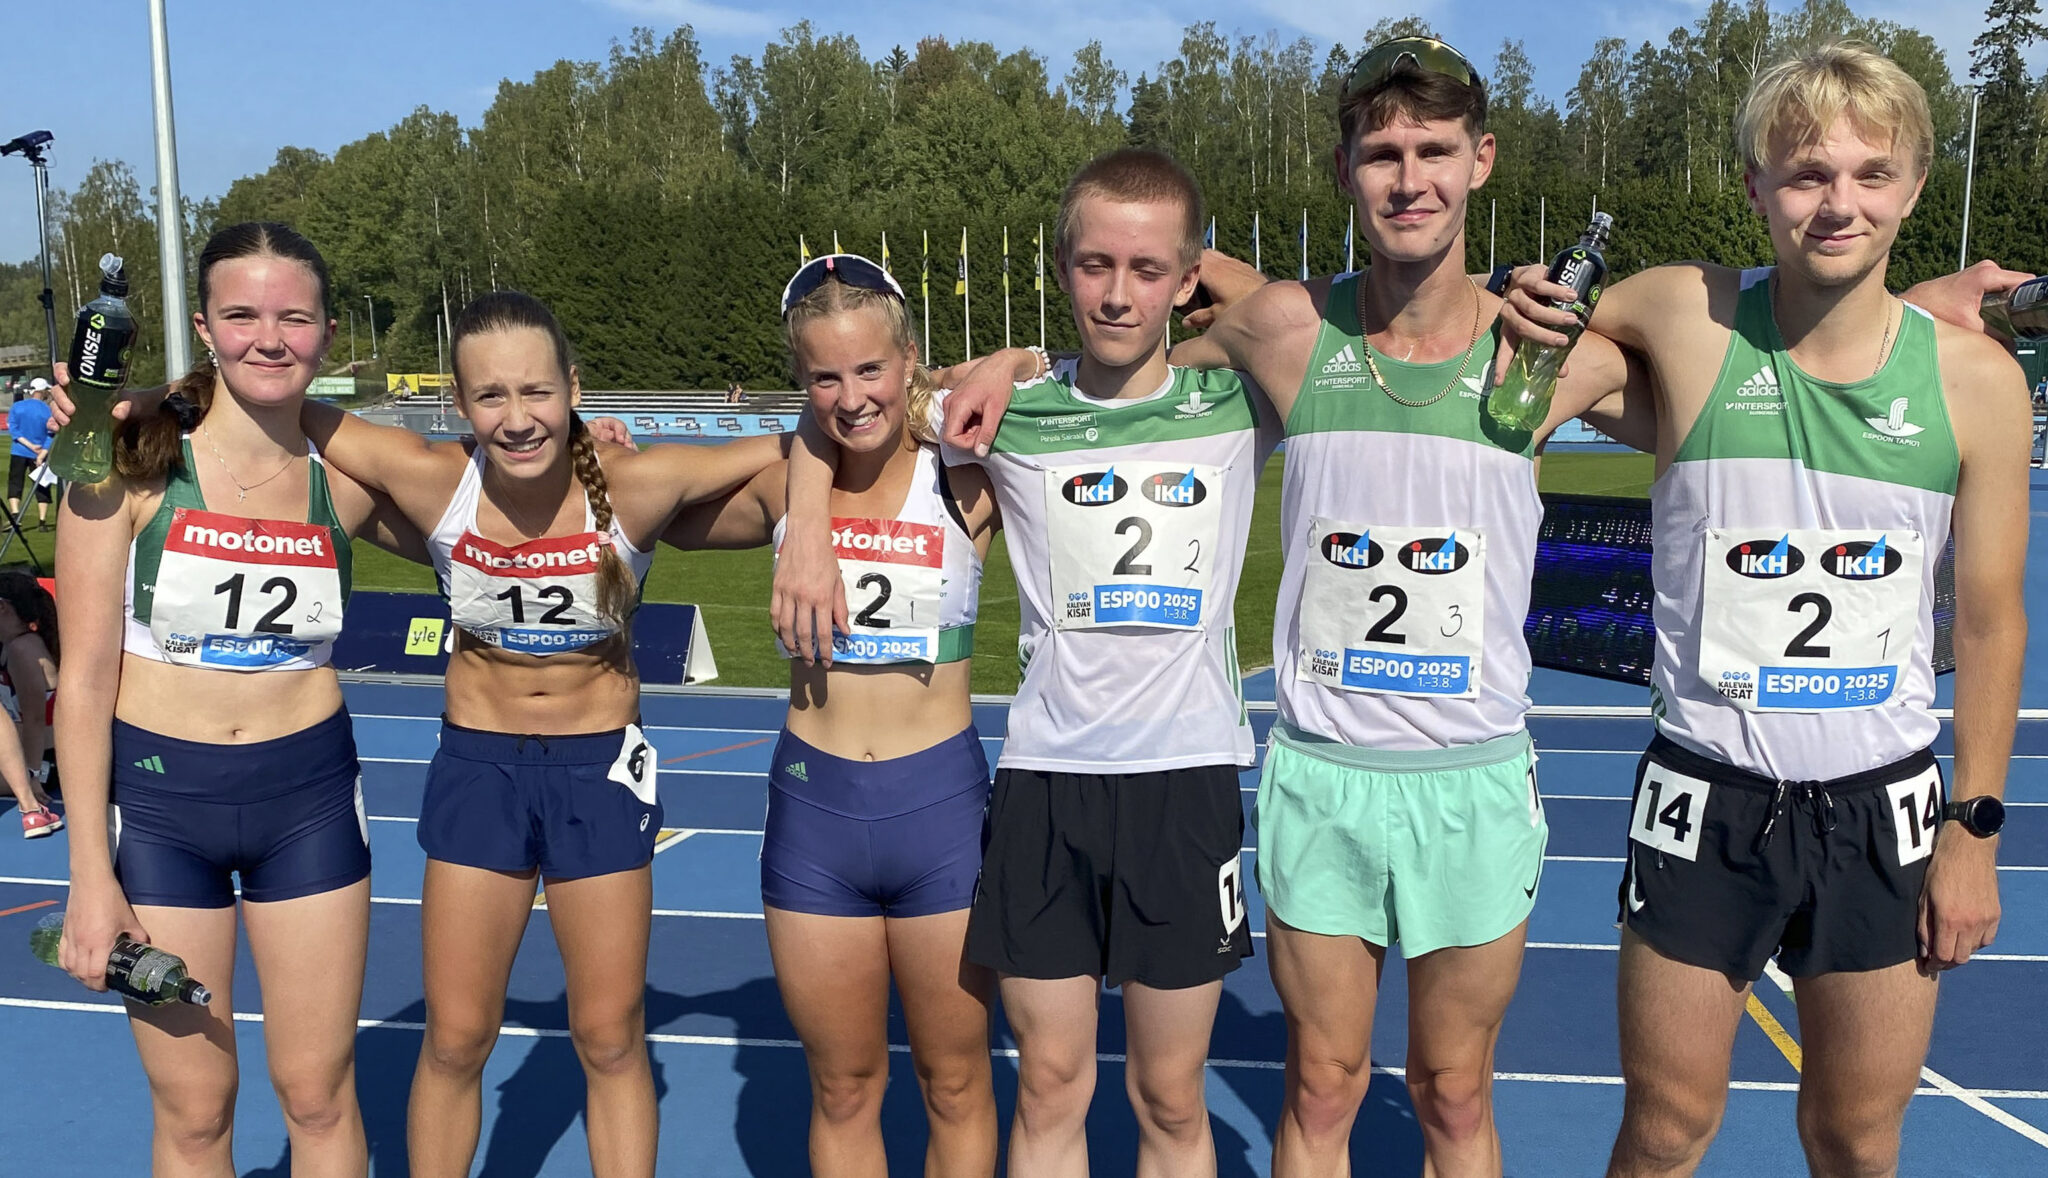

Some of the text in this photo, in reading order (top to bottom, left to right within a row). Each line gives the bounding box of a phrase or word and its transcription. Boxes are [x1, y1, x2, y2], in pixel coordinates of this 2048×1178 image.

[80, 328, 102, 376] ONSE
[1322, 361, 1362, 374] adidas
[1321, 376, 1368, 386] INTERSPORT
[1459, 390, 1481, 400] ESPOO
[1046, 415, 1092, 426] INTERSPORT
[1862, 431, 1920, 448] ESPOON TAPIOT
[184, 525, 324, 557] motonet
[831, 527, 928, 556] tonet
[1112, 516, 1152, 576] 2
[465, 541, 600, 569] motonet
[1184, 539, 1200, 573] 2
[214, 573, 297, 634] 12
[497, 585, 576, 625] 12
[839, 569, 892, 628] 2
[1066, 600, 1091, 609] KALEVAN
[1100, 592, 1197, 611] ESPOO 2025
[307, 602, 322, 624] 2
[1067, 607, 1091, 618] KISAT
[1364, 584, 1408, 645] 2
[1440, 604, 1463, 637] 3
[1784, 592, 1832, 658] 2
[411, 626, 436, 647] yle
[507, 632, 566, 646] ESPOO
[832, 637, 920, 657] SPOO 2025
[1877, 628, 1890, 660] 1
[165, 645, 198, 655] KISAT
[1311, 663, 1339, 678] KISAT
[1312, 657, 1339, 668] KALEVAN
[1350, 656, 1463, 679] ESPOO 2025
[1718, 681, 1753, 690] KALEVAN
[1719, 689, 1753, 699] KISAT
[1766, 674, 1889, 694] ESPOO 2025
[1644, 780, 1692, 842] 14
[1899, 781, 1940, 848] 14
